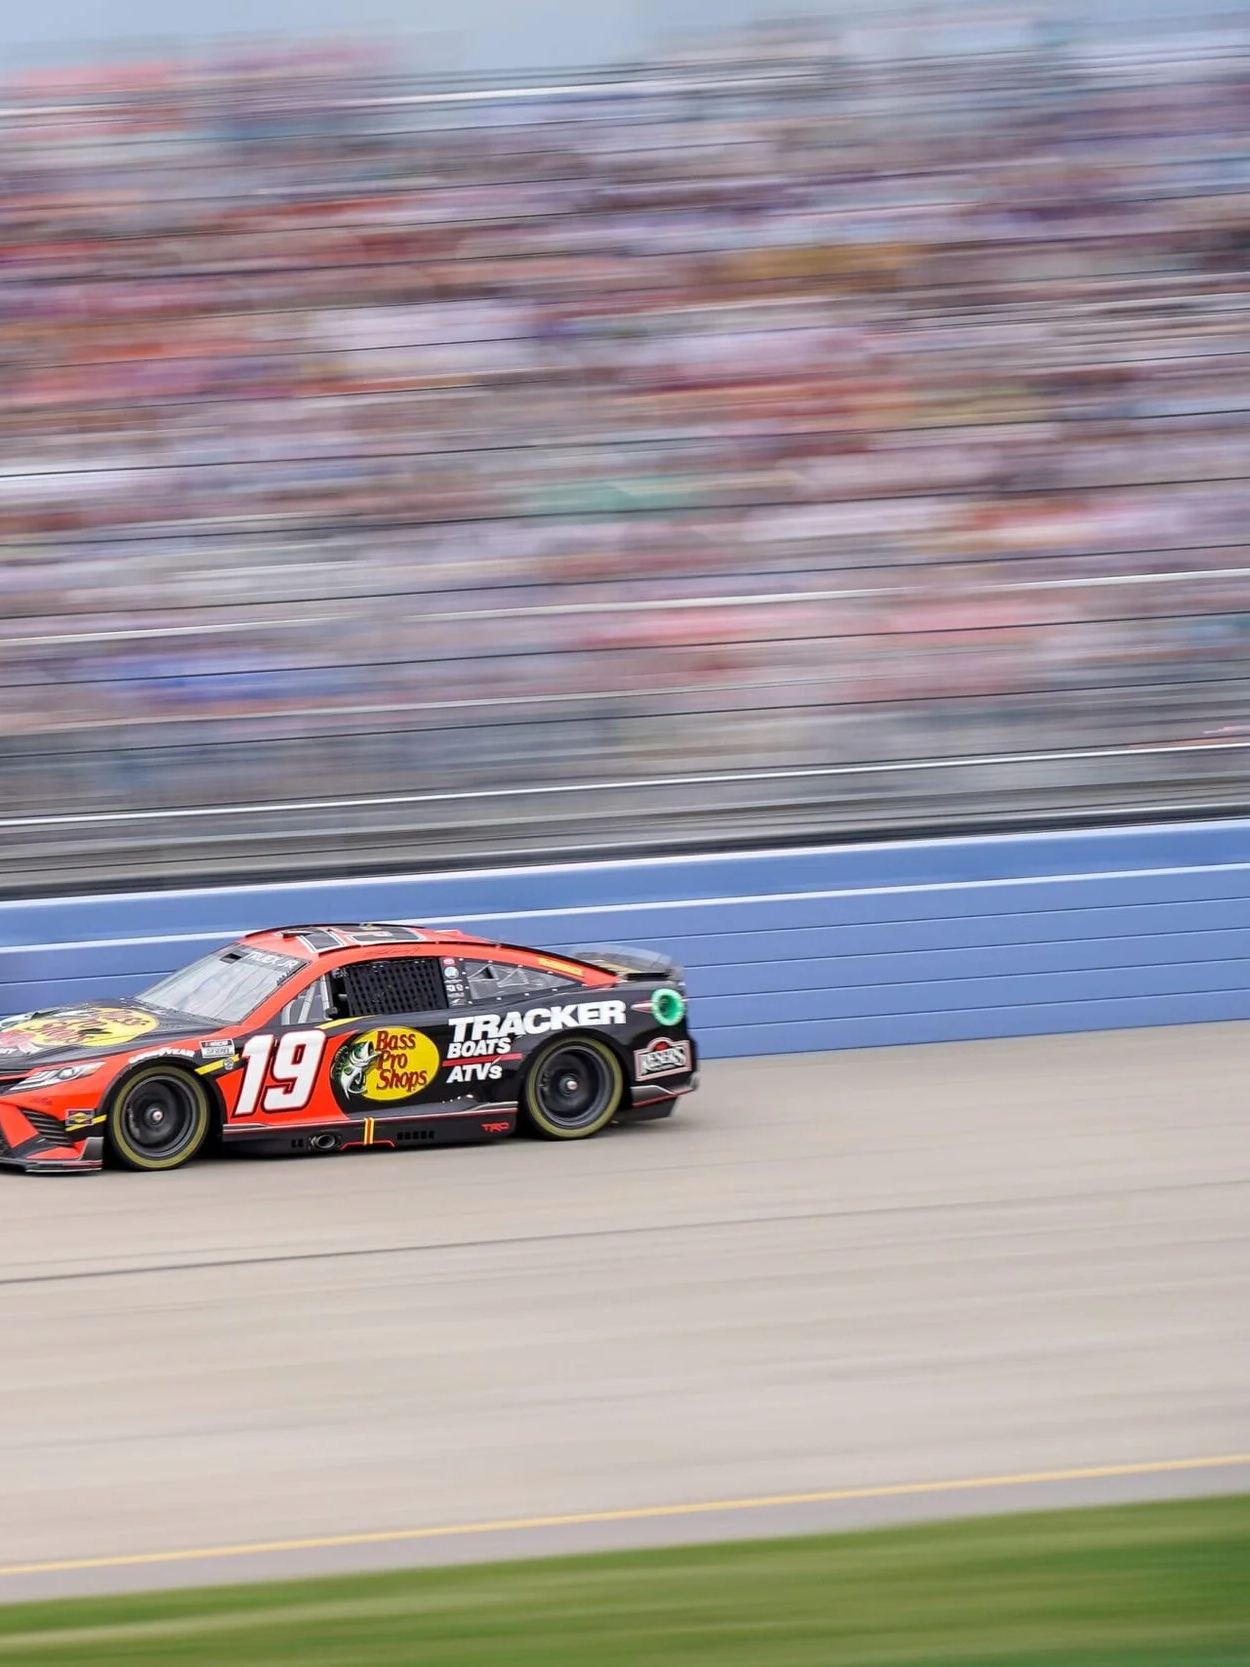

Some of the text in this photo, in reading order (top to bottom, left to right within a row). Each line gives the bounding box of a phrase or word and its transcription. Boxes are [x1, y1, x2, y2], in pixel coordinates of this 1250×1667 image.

[448, 1000, 627, 1043] TRACKER
[375, 1030, 417, 1051] Bass
[447, 1036, 512, 1060] BOATS
[376, 1050, 409, 1071] Pro
[232, 1028, 328, 1118] 19
[376, 1068, 429, 1093] Shops
[481, 1121, 510, 1133] TRD
